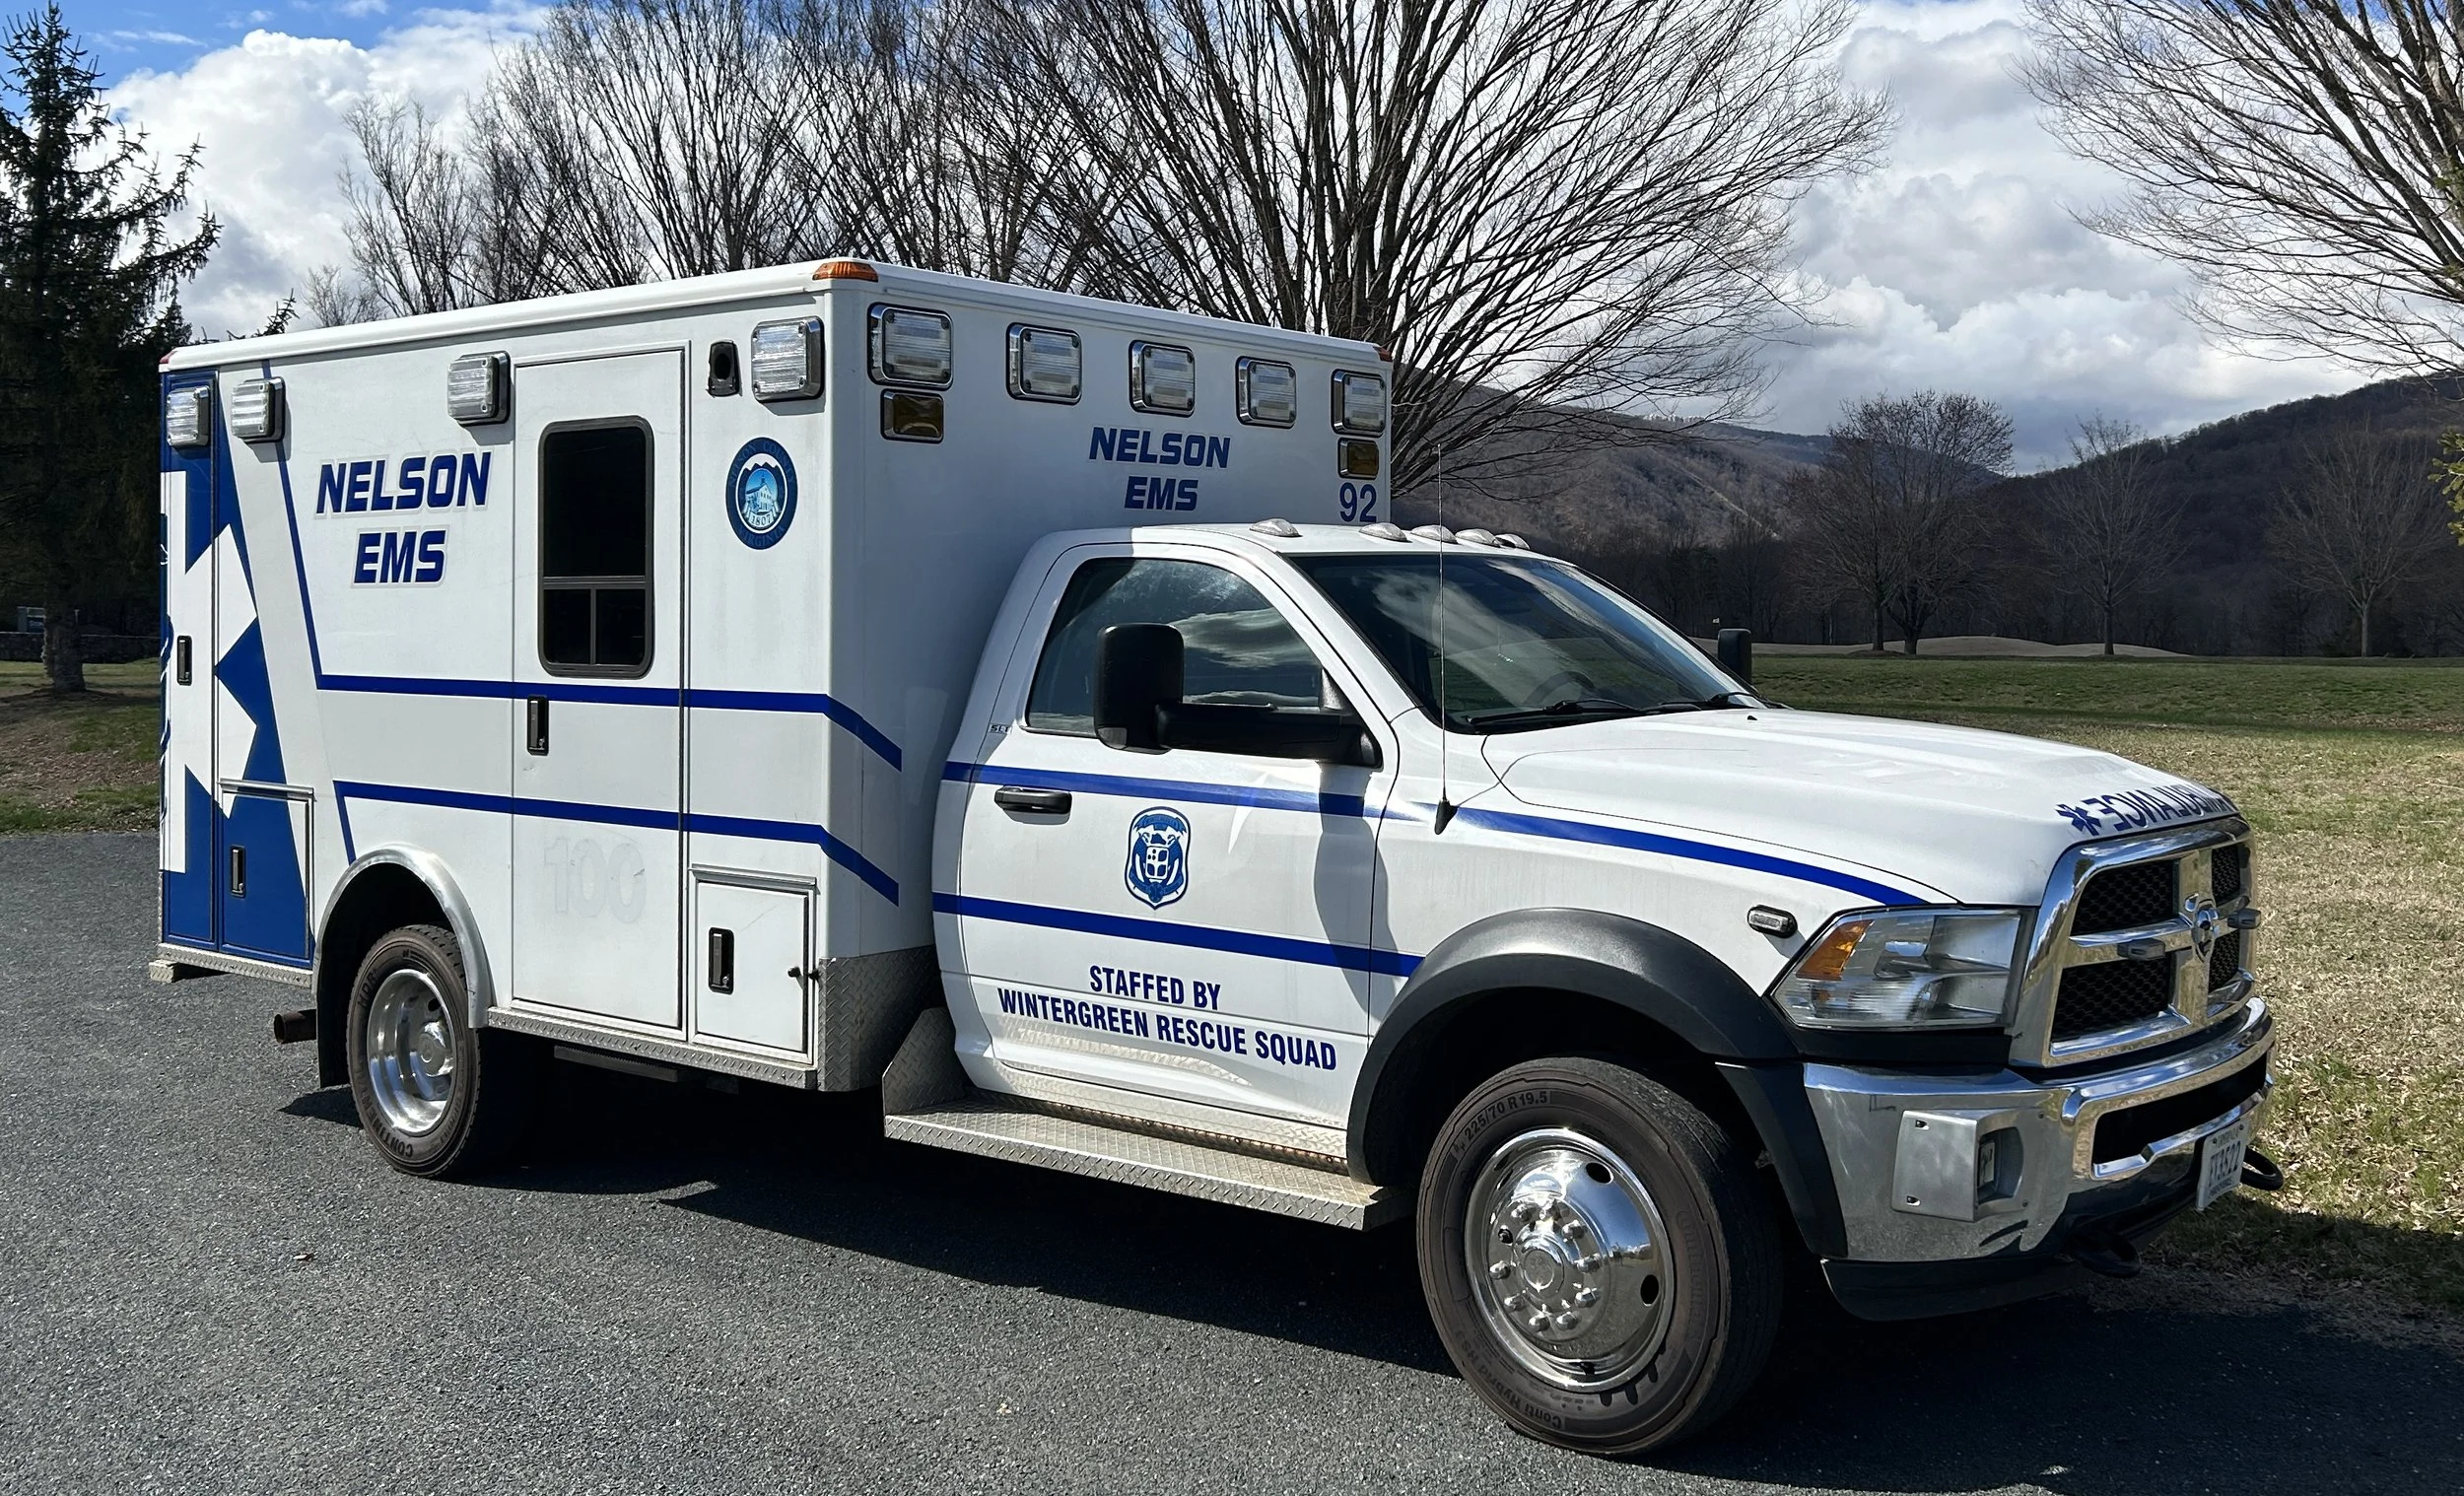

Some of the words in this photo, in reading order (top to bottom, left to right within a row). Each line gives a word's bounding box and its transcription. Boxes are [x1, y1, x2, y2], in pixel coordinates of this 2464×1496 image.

[1089, 426, 1231, 469] NELSON
[315, 451, 492, 514] NELSON
[1124, 475, 1198, 511] EMS
[1339, 481, 1377, 523] 92
[751, 514, 772, 526] 1807
[353, 529, 446, 583] EMS
[1089, 965, 1185, 1005] STAFFED
[1193, 980, 1221, 1011] BY
[996, 987, 1150, 1038] WINTERGREEN
[1155, 1013, 1248, 1055] RESCUE
[1255, 1030, 1337, 1070] SQUAD
[1465, 1102, 1505, 1140] 225/70
[1524, 1402, 1562, 1430] Conti
